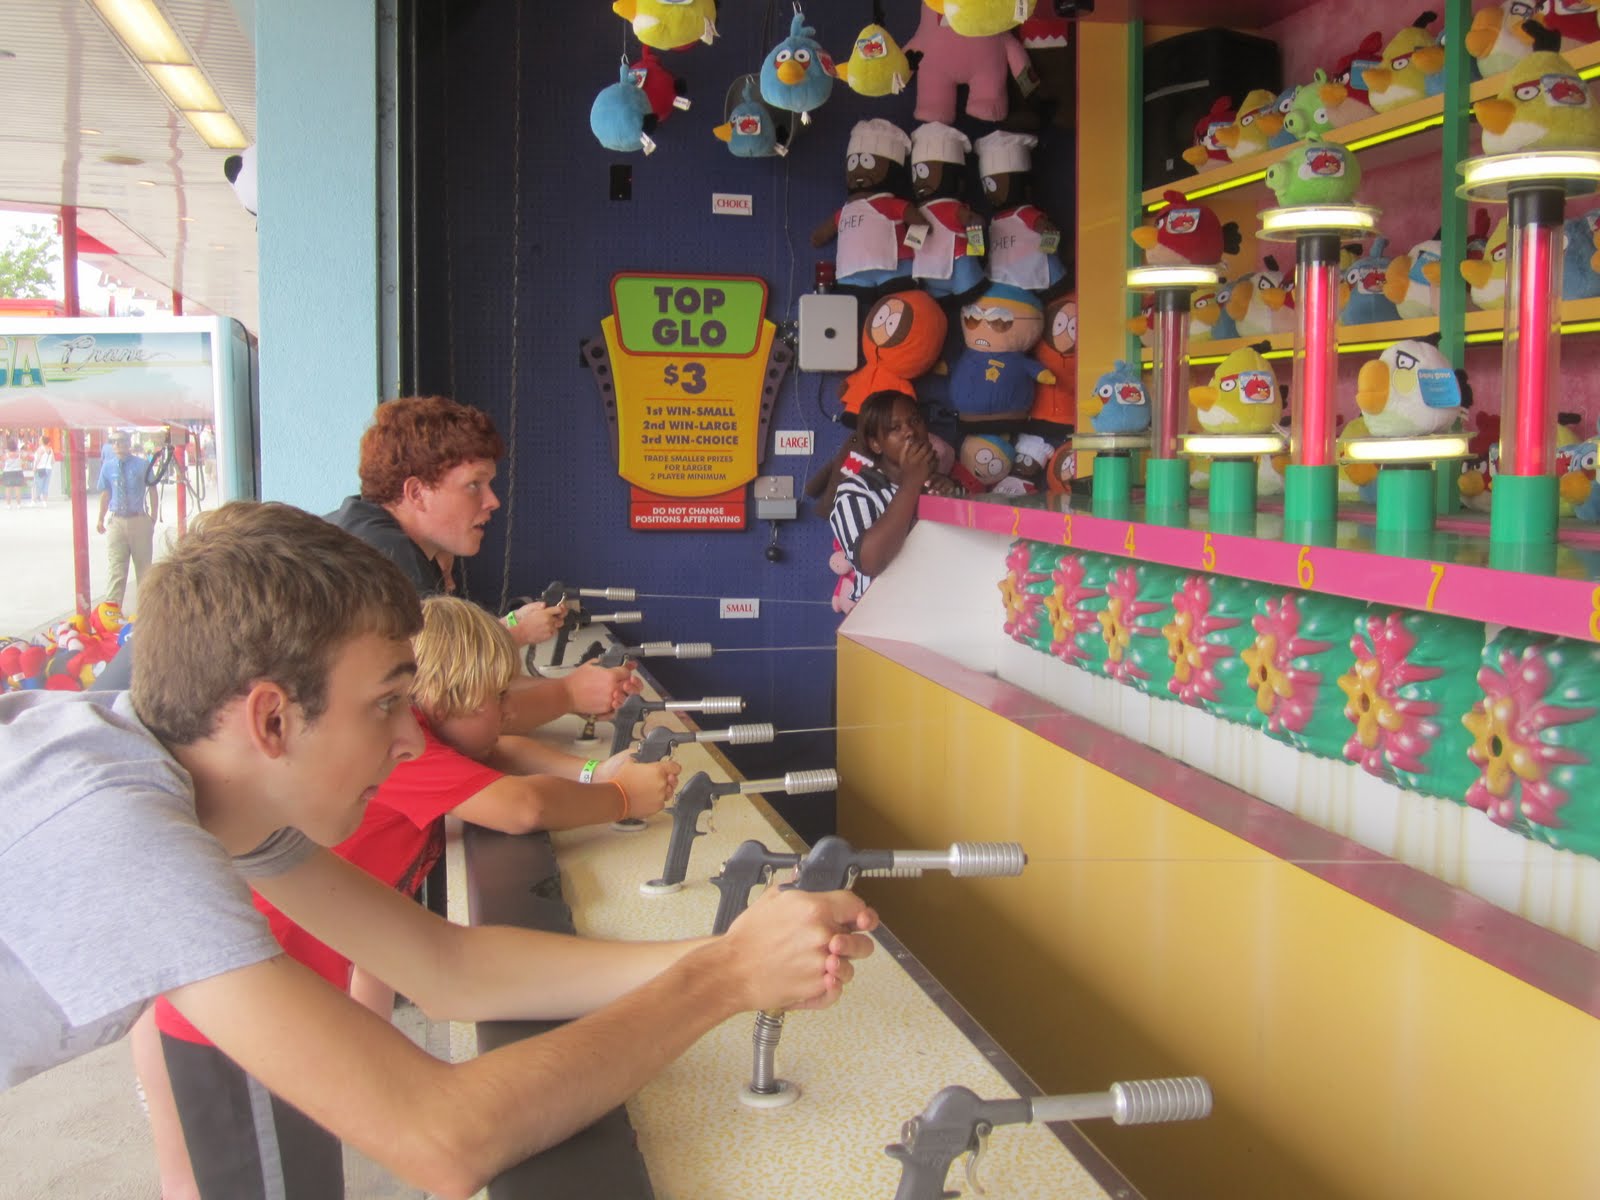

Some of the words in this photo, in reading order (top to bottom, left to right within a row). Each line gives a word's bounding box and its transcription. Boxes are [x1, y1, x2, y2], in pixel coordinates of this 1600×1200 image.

[716, 198, 750, 209] CHOICE
[839, 214, 865, 233] CHEF
[653, 286, 726, 315] TOP
[652, 318, 727, 347] GLO
[57, 335, 158, 374] Crane
[663, 362, 707, 394] $3
[642, 420, 666, 430] 2nd
[669, 421, 738, 431] WIN-LARGE
[645, 406, 663, 416] 1st
[666, 406, 736, 417] WIN-SMALL
[641, 434, 662, 445] 3rd
[665, 435, 739, 445] WIN-CHOICE
[780, 436, 809, 448] LARGE
[671, 455, 705, 463] SMALLER
[635, 515, 681, 523] POSITIONS
[682, 515, 708, 524] AFTER
[709, 515, 741, 524] PAYING
[652, 507, 666, 515] DO
[668, 507, 686, 515] NOT
[688, 507, 724, 515] CHANGE
[1011, 508, 1021, 536] 2
[1063, 514, 1073, 545] 3
[1124, 524, 1136, 557] 4
[1202, 533, 1216, 571] 5
[1297, 546, 1314, 590] 6
[1426, 564, 1445, 610] 7
[726, 603, 753, 612] SMALL
[1588, 585, 1600, 641] 8
